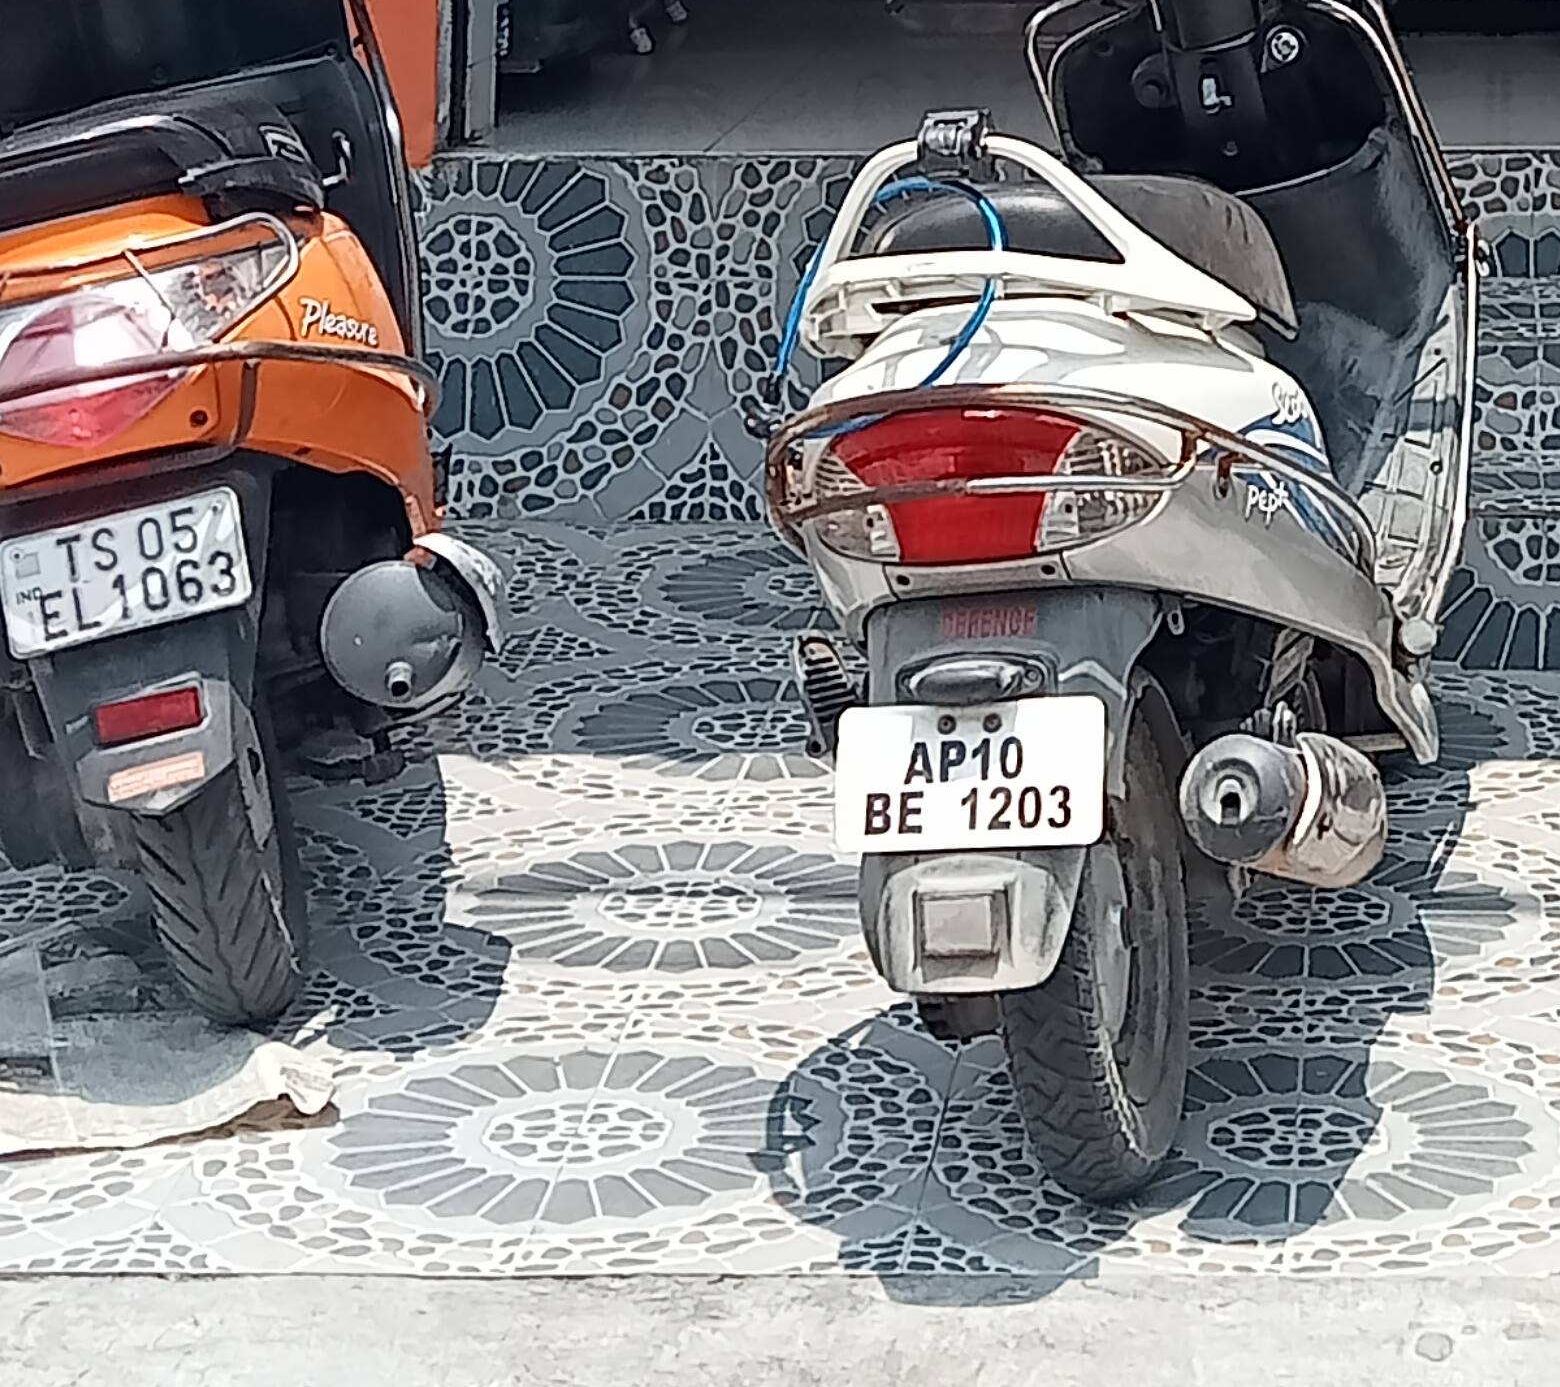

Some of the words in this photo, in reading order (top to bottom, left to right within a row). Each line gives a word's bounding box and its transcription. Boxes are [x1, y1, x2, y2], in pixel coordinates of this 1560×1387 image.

[300, 298, 379, 347] Pleasure
[56, 527, 118, 579] TS
[138, 506, 199, 571] 05
[864, 792, 924, 836] BE
[961, 785, 1072, 831] 1203
